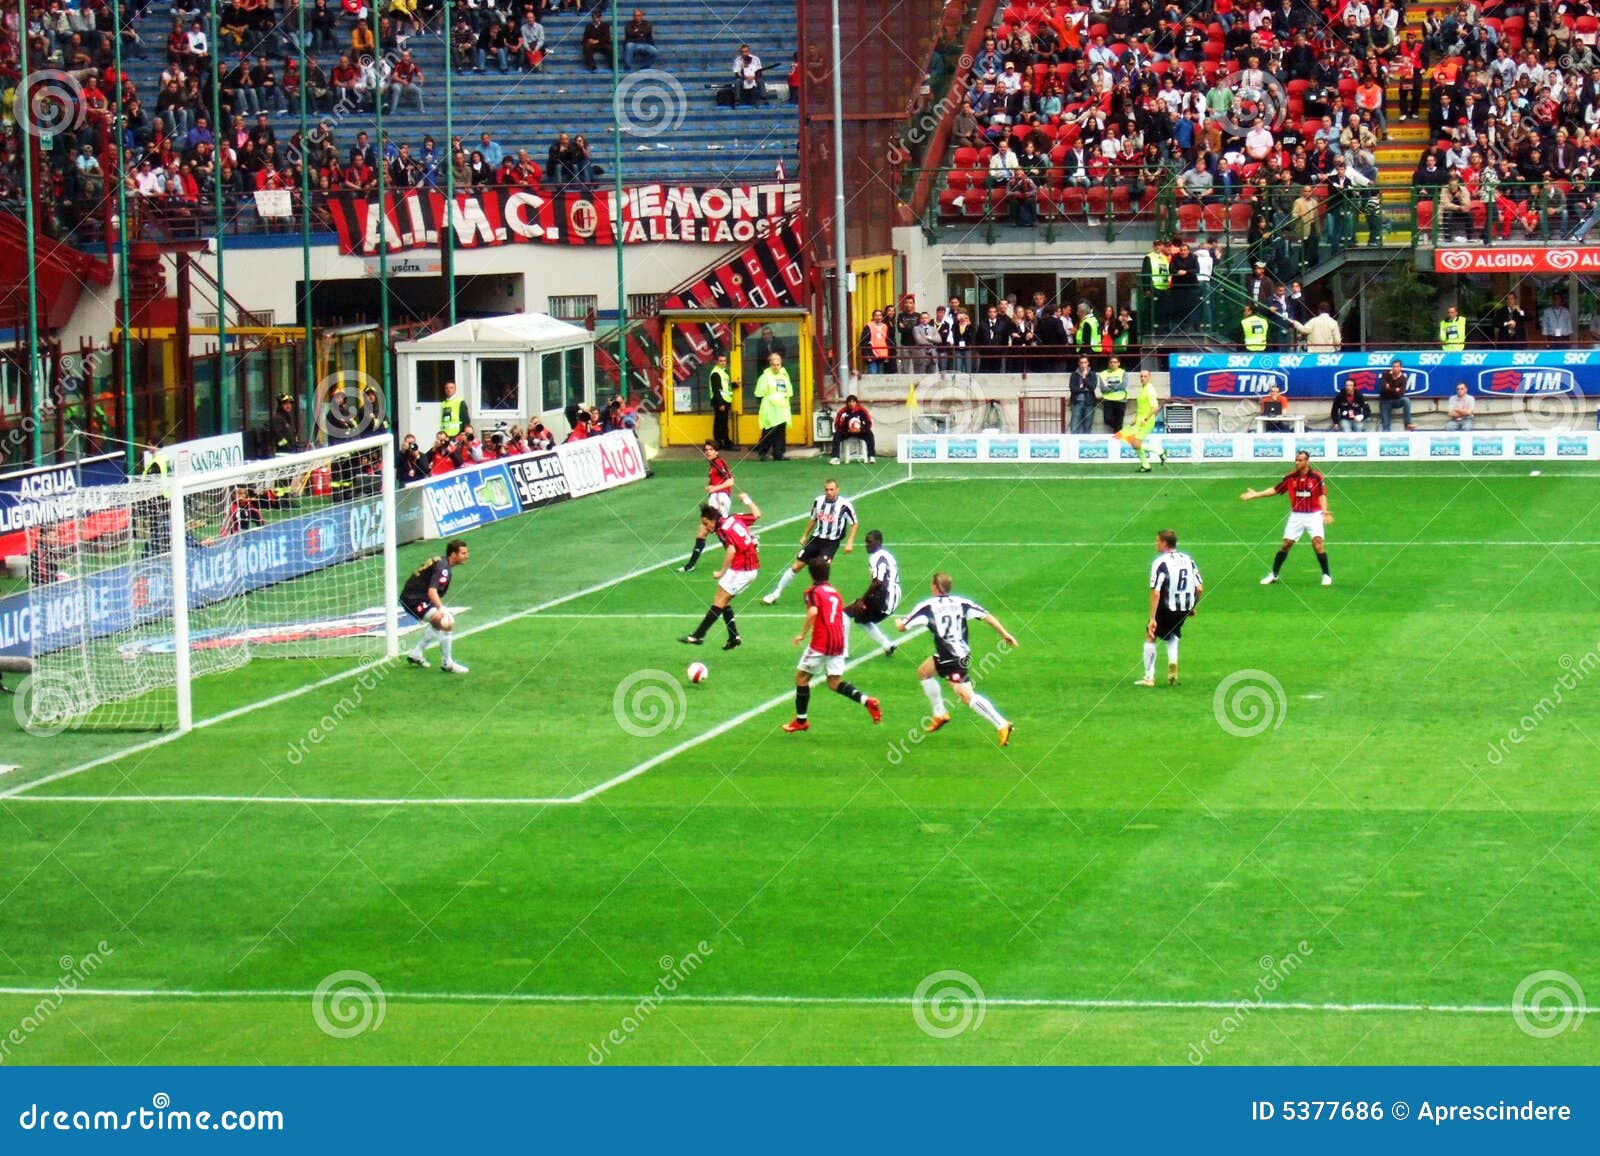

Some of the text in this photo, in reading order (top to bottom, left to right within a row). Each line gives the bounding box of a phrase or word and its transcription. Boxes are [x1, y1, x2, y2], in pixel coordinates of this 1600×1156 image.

[608, 184, 800, 220] PIEMONTE
[610, 218, 695, 242] VALLE
[391, 265, 421, 273] USCITA
[1475, 253, 1534, 267] ALGIDA
[1177, 353, 1591, 367] SKY SKY SKY SKY SKY SKY SKY SKY SKY
[1238, 372, 1562, 392] TIM TIM
[599, 437, 642, 482] Audi
[21, 469, 77, 499] ACQUA
[426, 475, 476, 521] Bavaria
[732, 522, 753, 546] 9
[191, 551, 233, 592] ALICE
[237, 535, 289, 578] MOBILE
[1178, 568, 1188, 592] 6
[828, 596, 839, 624] 7
